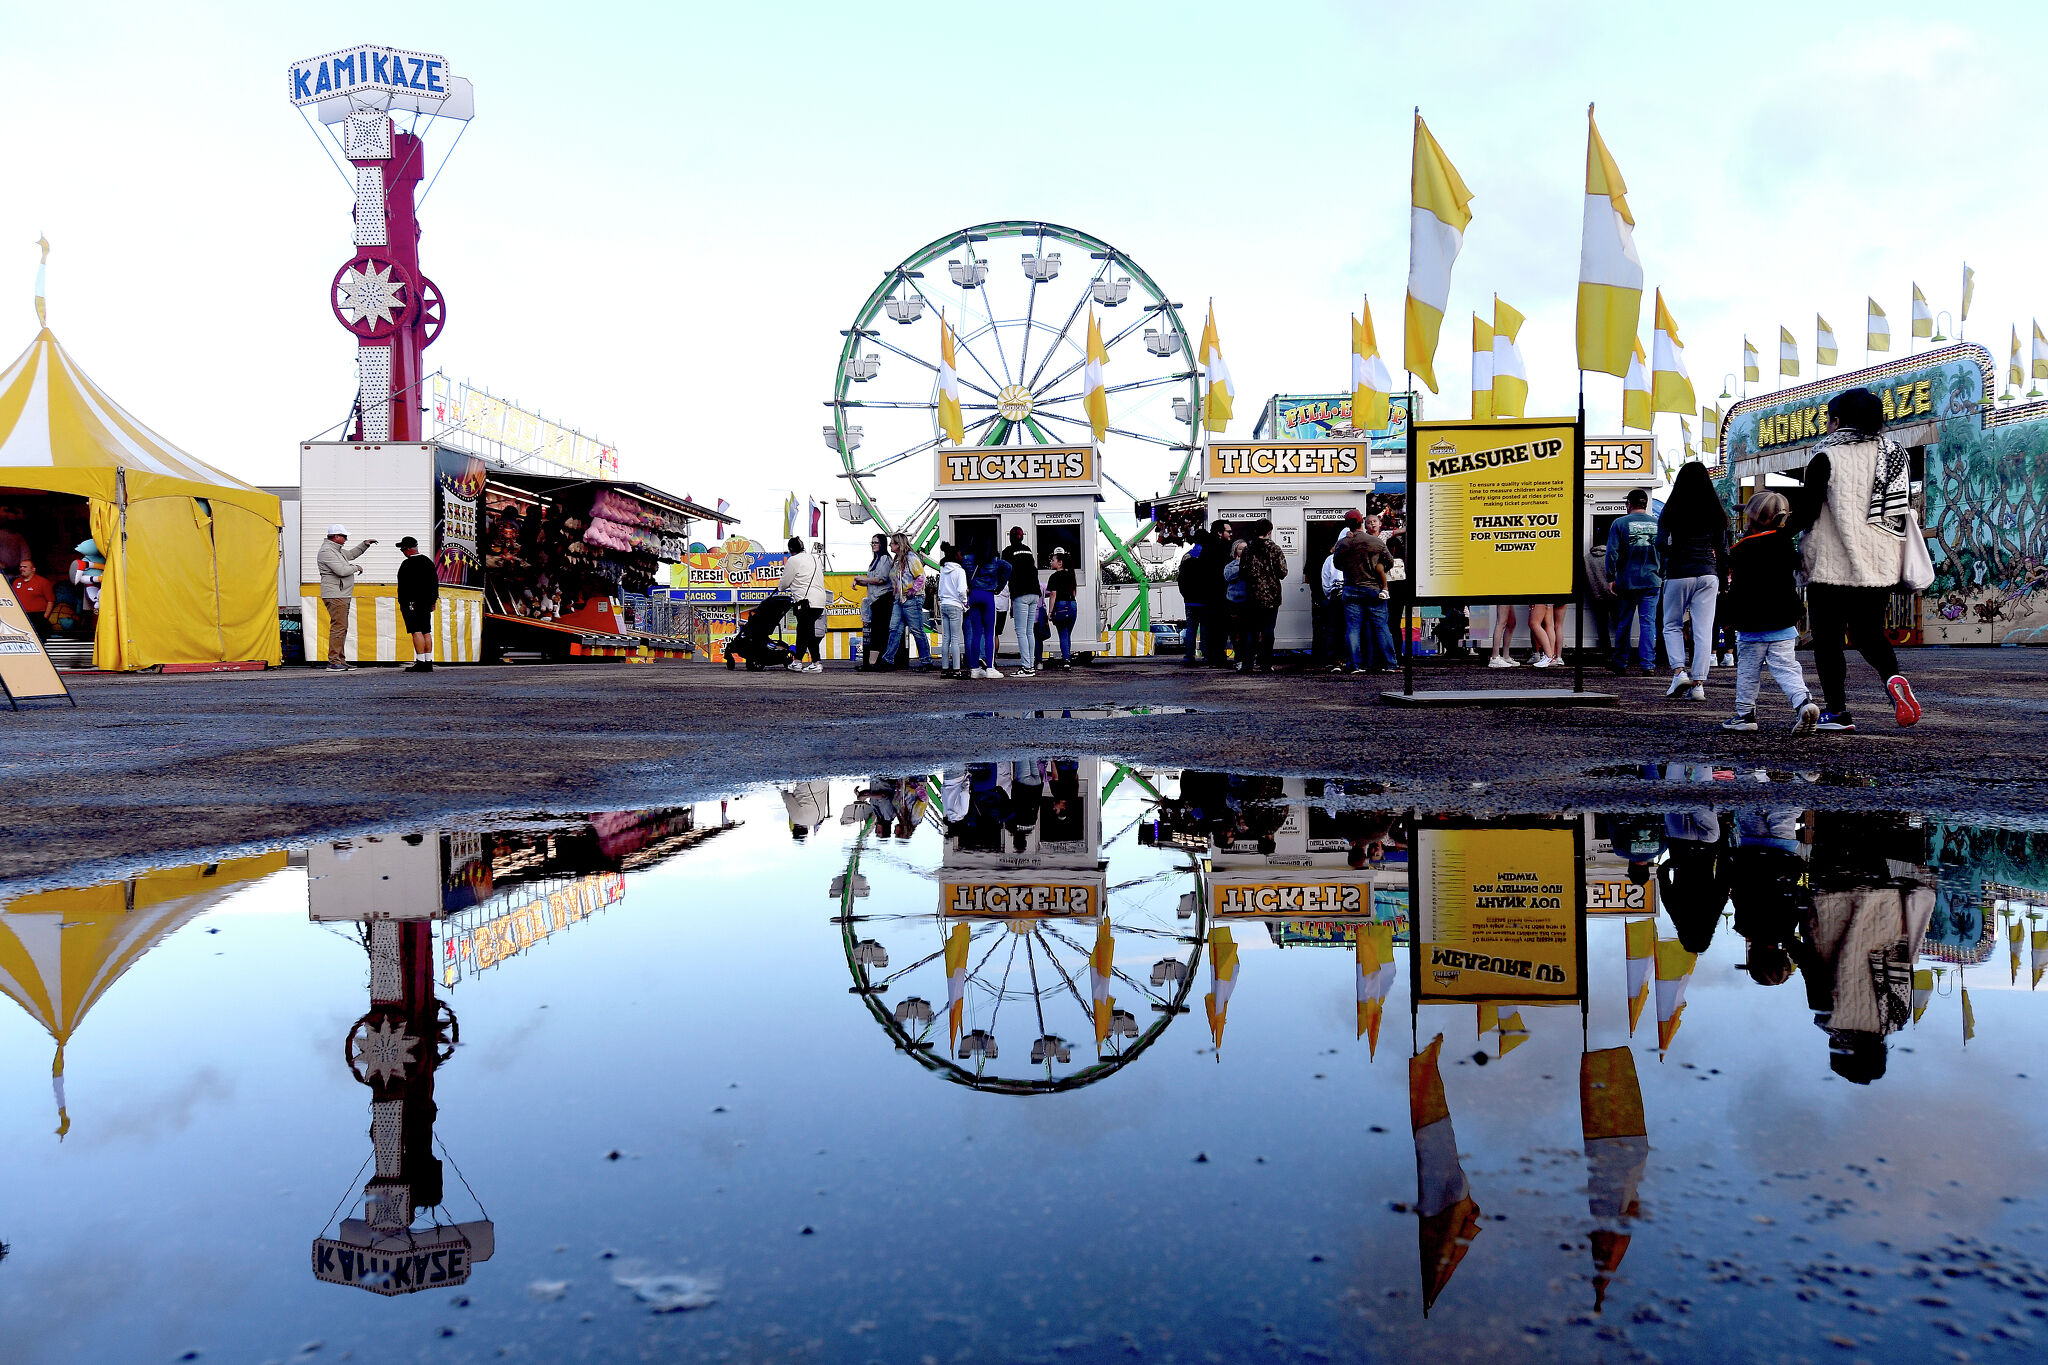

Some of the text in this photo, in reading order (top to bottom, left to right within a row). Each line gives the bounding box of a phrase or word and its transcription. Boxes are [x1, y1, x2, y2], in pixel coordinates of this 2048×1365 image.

[293, 51, 444, 100] KAMIKAZE
[1881, 379, 1932, 420] AZE
[1758, 404, 1829, 447] MONKE
[947, 453, 1084, 481] TICKETS
[1218, 448, 1357, 474] TICKETS
[1428, 445, 1529, 478] MEASURE
[1532, 439, 1562, 458] UP
[1473, 514, 1559, 528] THANK YOU
[1282, 535, 1292, 544] $1
[1470, 530, 1561, 540] FOR VISITING OUR
[1495, 543, 1536, 552] MIDWAY
[690, 570, 724, 581] FRESH
[729, 571, 750, 582] CUT
